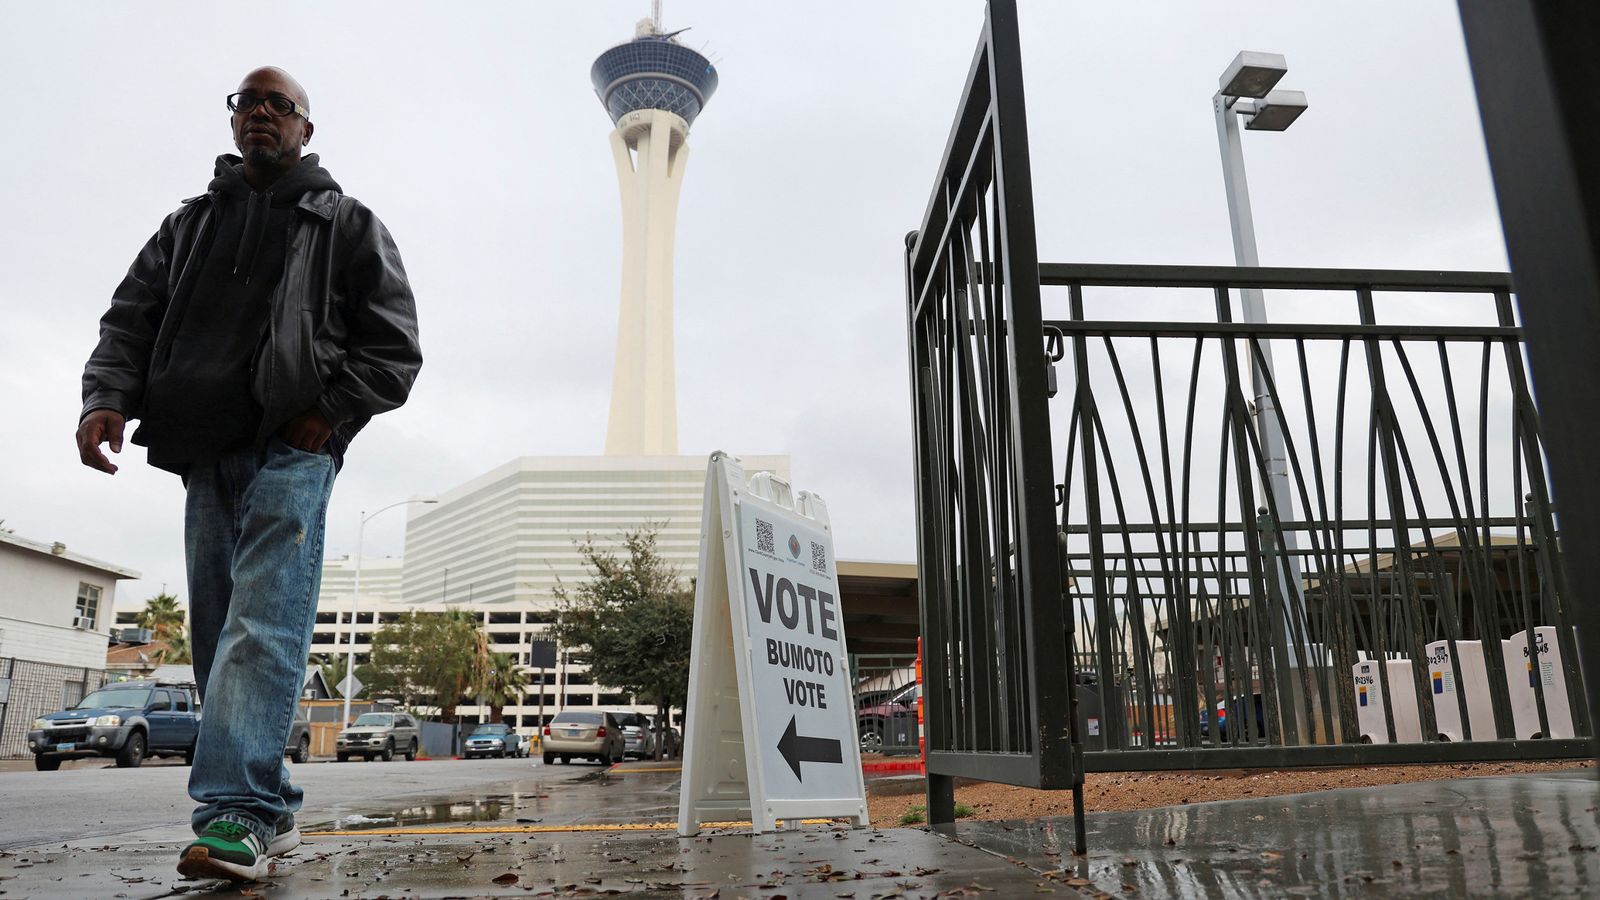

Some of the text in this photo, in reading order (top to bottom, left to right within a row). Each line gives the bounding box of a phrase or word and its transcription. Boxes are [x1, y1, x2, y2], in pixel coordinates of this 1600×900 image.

[749, 567, 838, 641] VOTE
[766, 638, 834, 676] BUMOTO
[783, 677, 827, 709] VOTE
